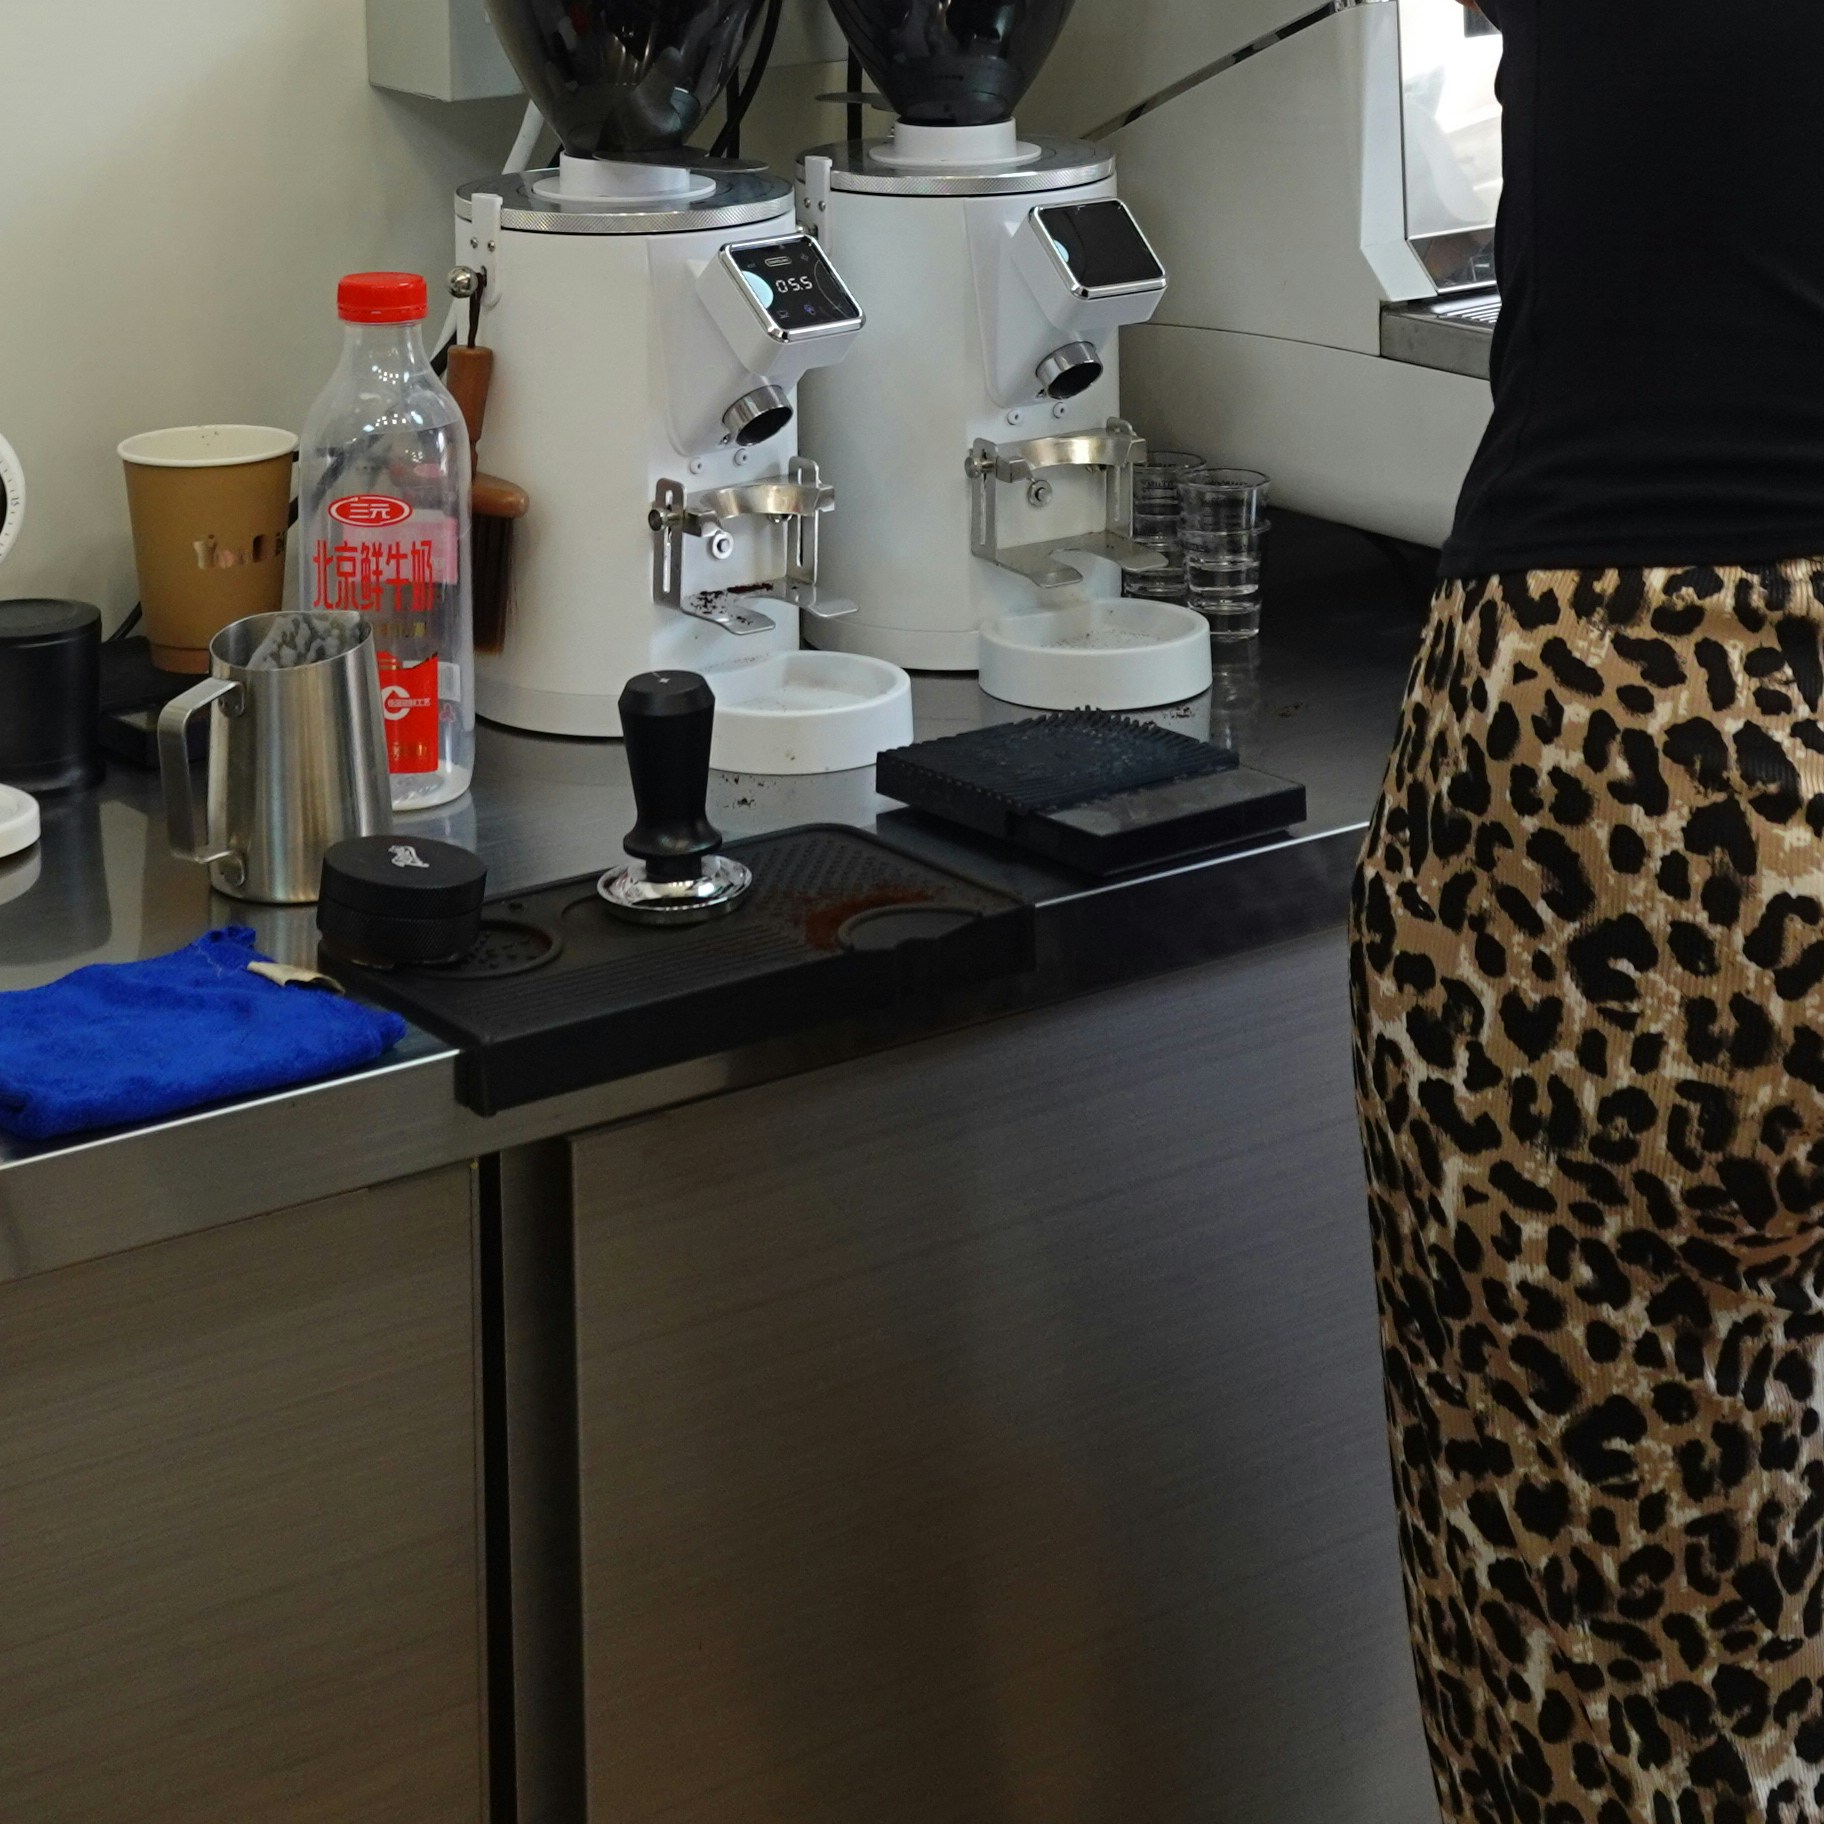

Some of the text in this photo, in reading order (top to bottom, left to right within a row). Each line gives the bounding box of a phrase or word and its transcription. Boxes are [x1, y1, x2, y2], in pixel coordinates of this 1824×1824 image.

[775, 275, 813, 293] 05.5
[350, 502, 391, 520] 三元
[313, 540, 434, 611] 北京鲜牛奶
